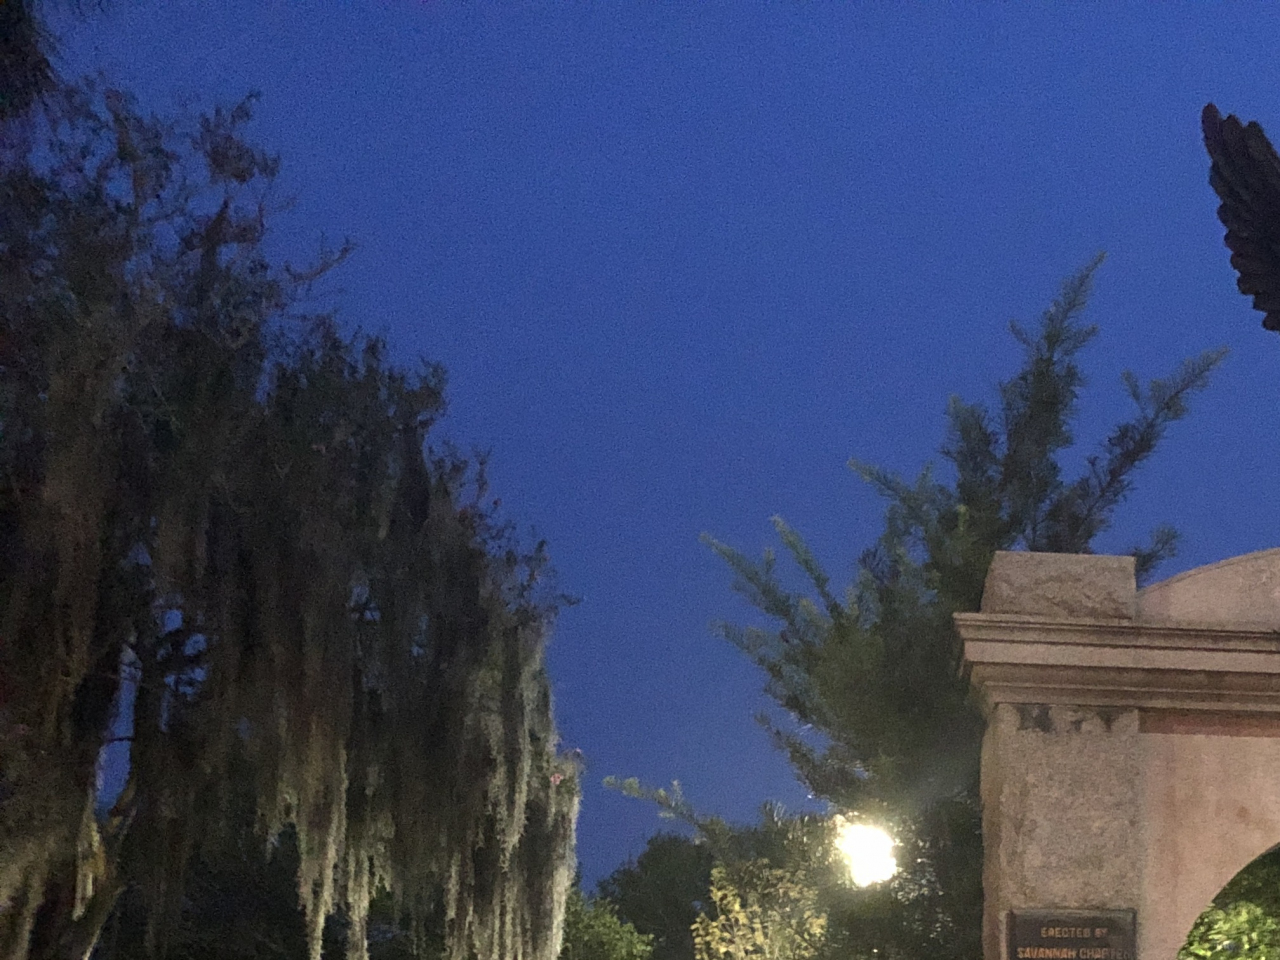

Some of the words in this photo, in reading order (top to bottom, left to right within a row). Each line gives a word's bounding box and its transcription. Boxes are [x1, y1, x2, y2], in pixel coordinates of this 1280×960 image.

[1040, 927, 1091, 938] ERECTED
[1093, 927, 1109, 938] BY
[1016, 946, 1077, 960] SAVANNAH
